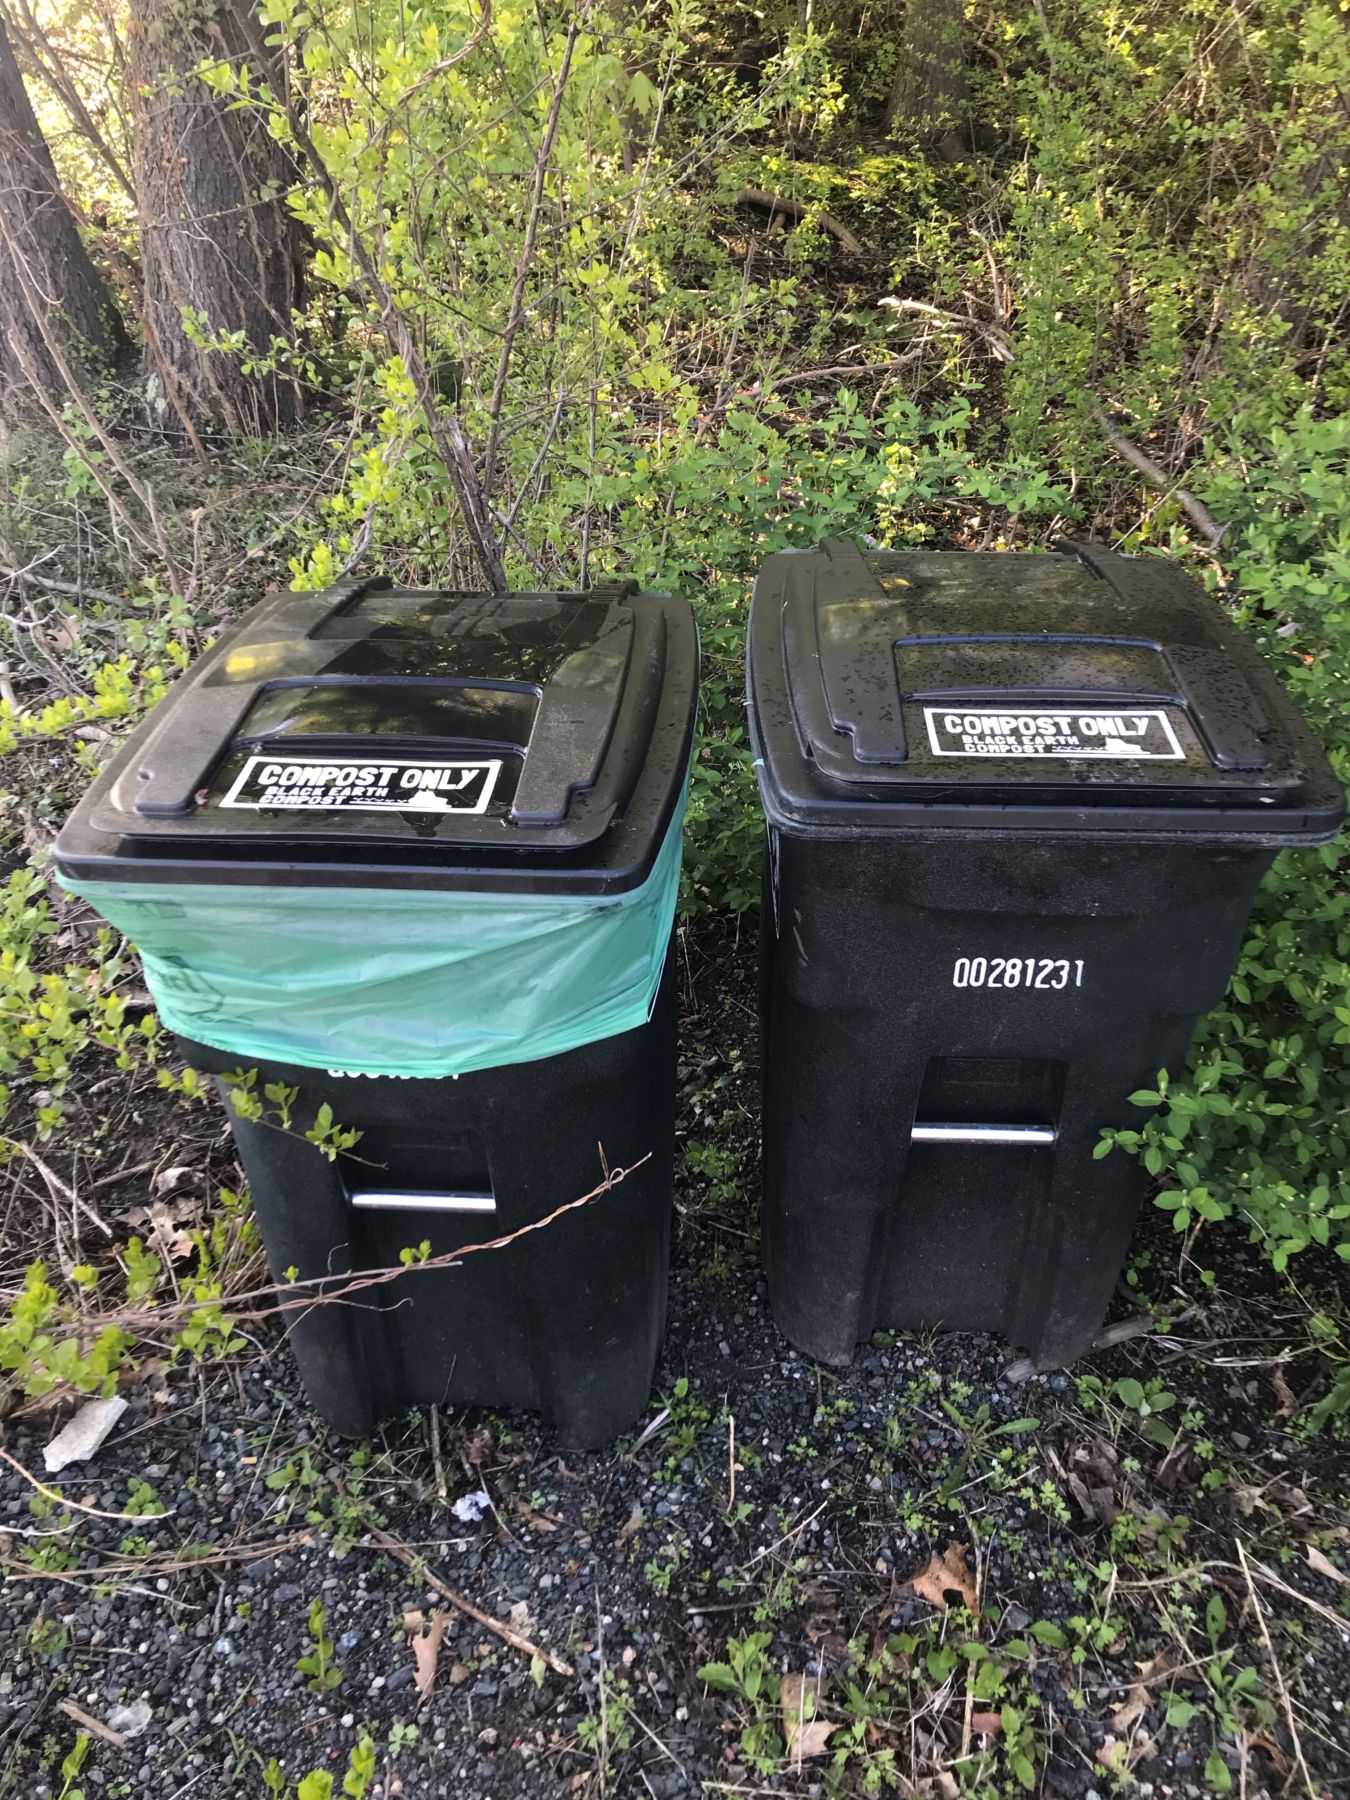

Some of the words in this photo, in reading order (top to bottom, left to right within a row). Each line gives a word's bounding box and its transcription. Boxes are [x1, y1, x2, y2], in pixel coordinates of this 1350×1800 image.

[944, 715, 1072, 736] COMPOST
[1078, 717, 1150, 737] ONLY
[962, 735, 1017, 745] BLACK
[1021, 735, 1080, 746] EARTH
[964, 744, 1045, 753] COMPOST
[257, 764, 400, 787] COMPOST
[400, 768, 480, 790] ONLY
[263, 786, 328, 797] BLACK
[328, 786, 389, 798] EARTH
[258, 795, 348, 805] COMPOST
